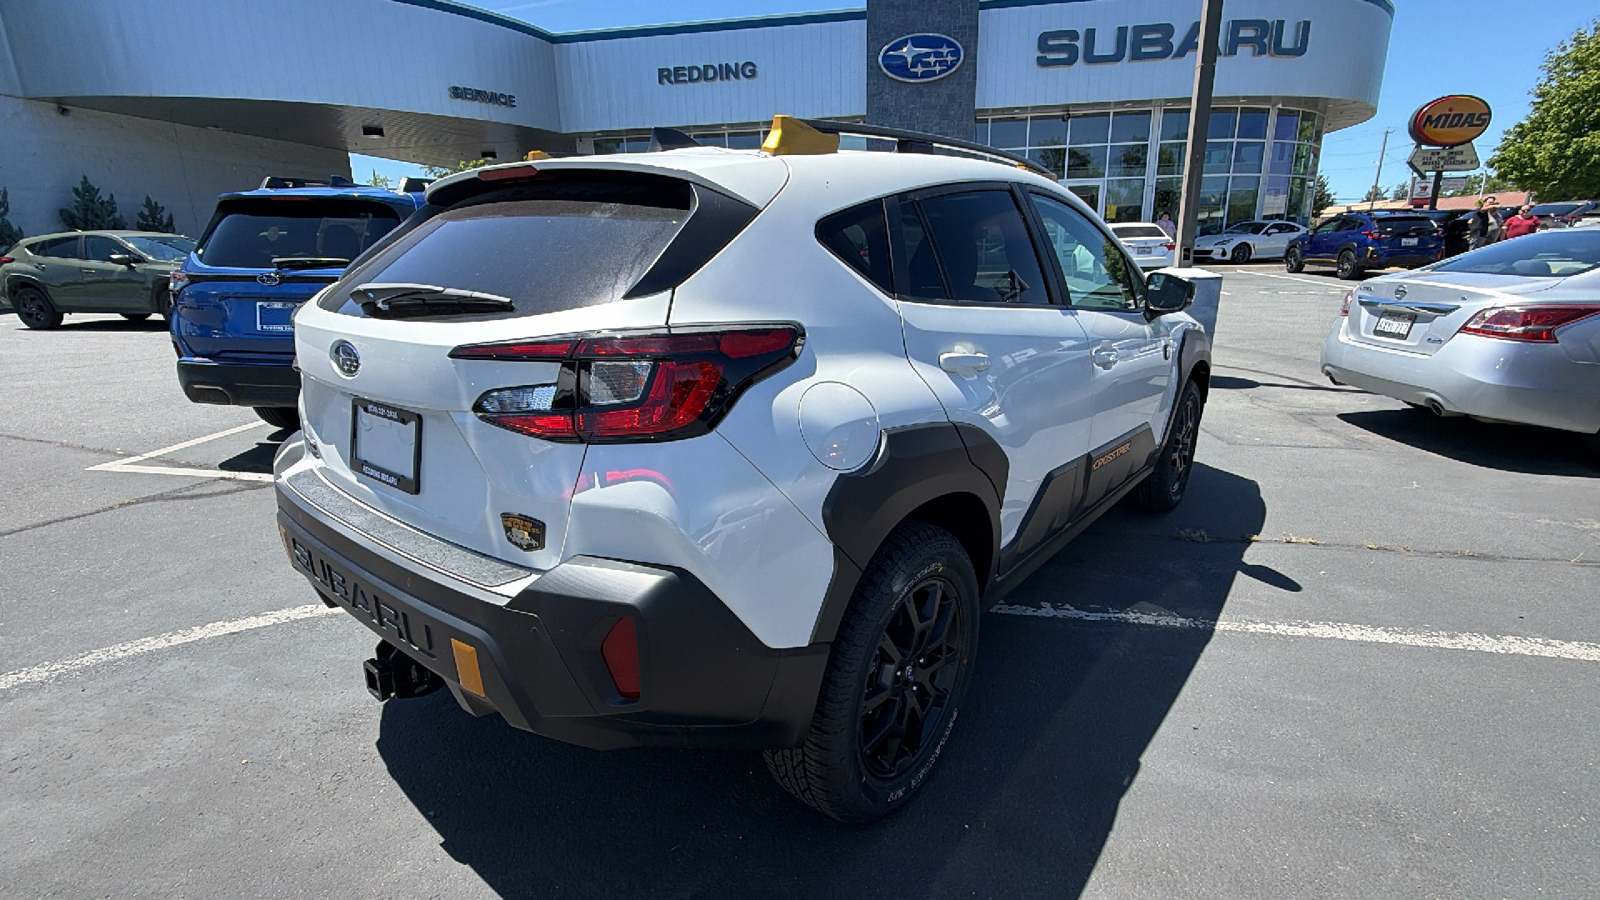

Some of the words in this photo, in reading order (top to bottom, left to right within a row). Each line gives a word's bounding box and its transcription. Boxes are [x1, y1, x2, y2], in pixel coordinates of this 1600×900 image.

[1036, 19, 1311, 68] SUBARU
[658, 61, 757, 85] REDDING
[449, 86, 517, 108] SERVICE
[1423, 112, 1489, 129] MIDAS
[1092, 442, 1131, 471] CROSSTREK
[291, 537, 437, 660] SUBARU
